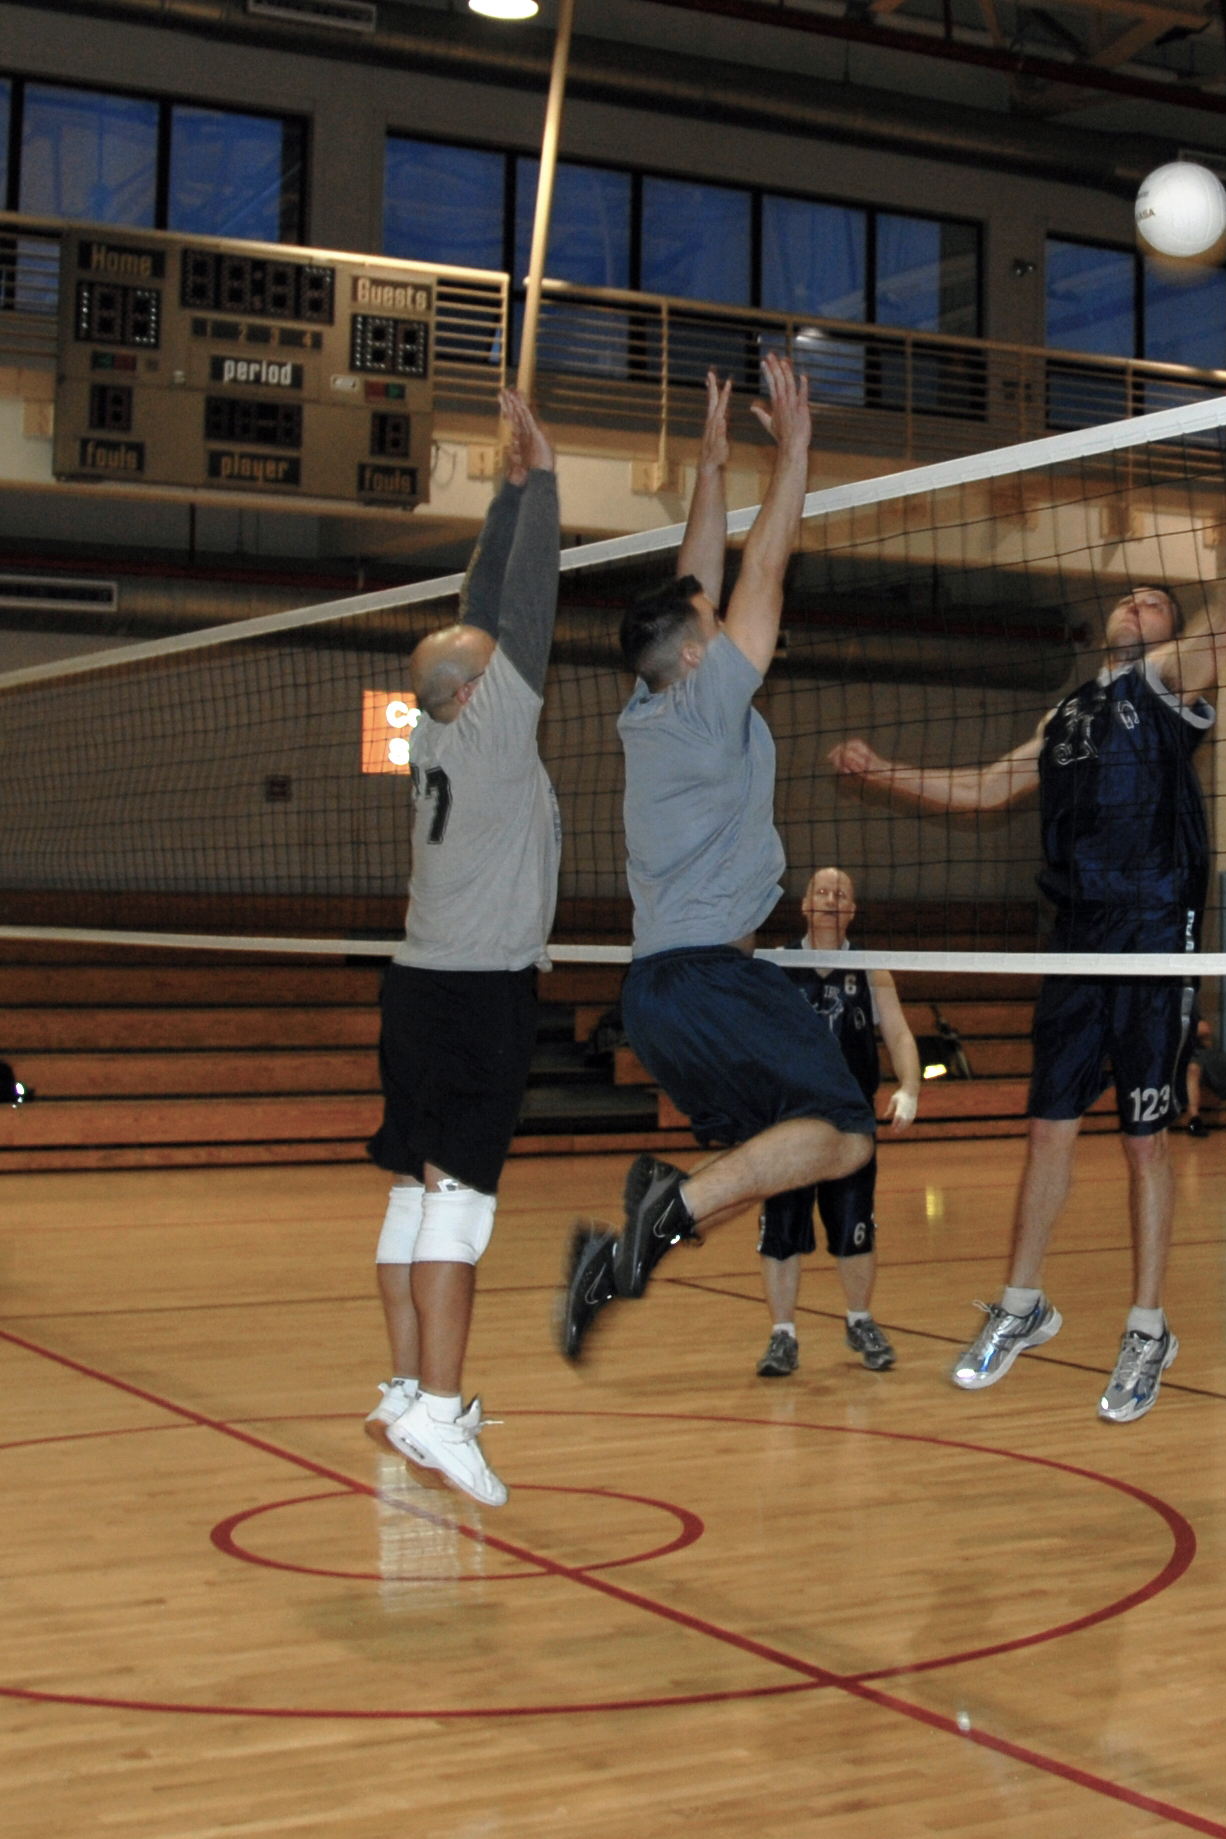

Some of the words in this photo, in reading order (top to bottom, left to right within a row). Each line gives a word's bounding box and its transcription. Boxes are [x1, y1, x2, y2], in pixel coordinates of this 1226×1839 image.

[91, 244, 152, 275] Home
[357, 278, 429, 310] Guests
[223, 358, 292, 386] period
[86, 440, 138, 469] fouls
[220, 456, 289, 485] player
[363, 467, 411, 494] fouls
[1130, 1083, 1171, 1123] 123
[852, 1221, 867, 1248] 6
